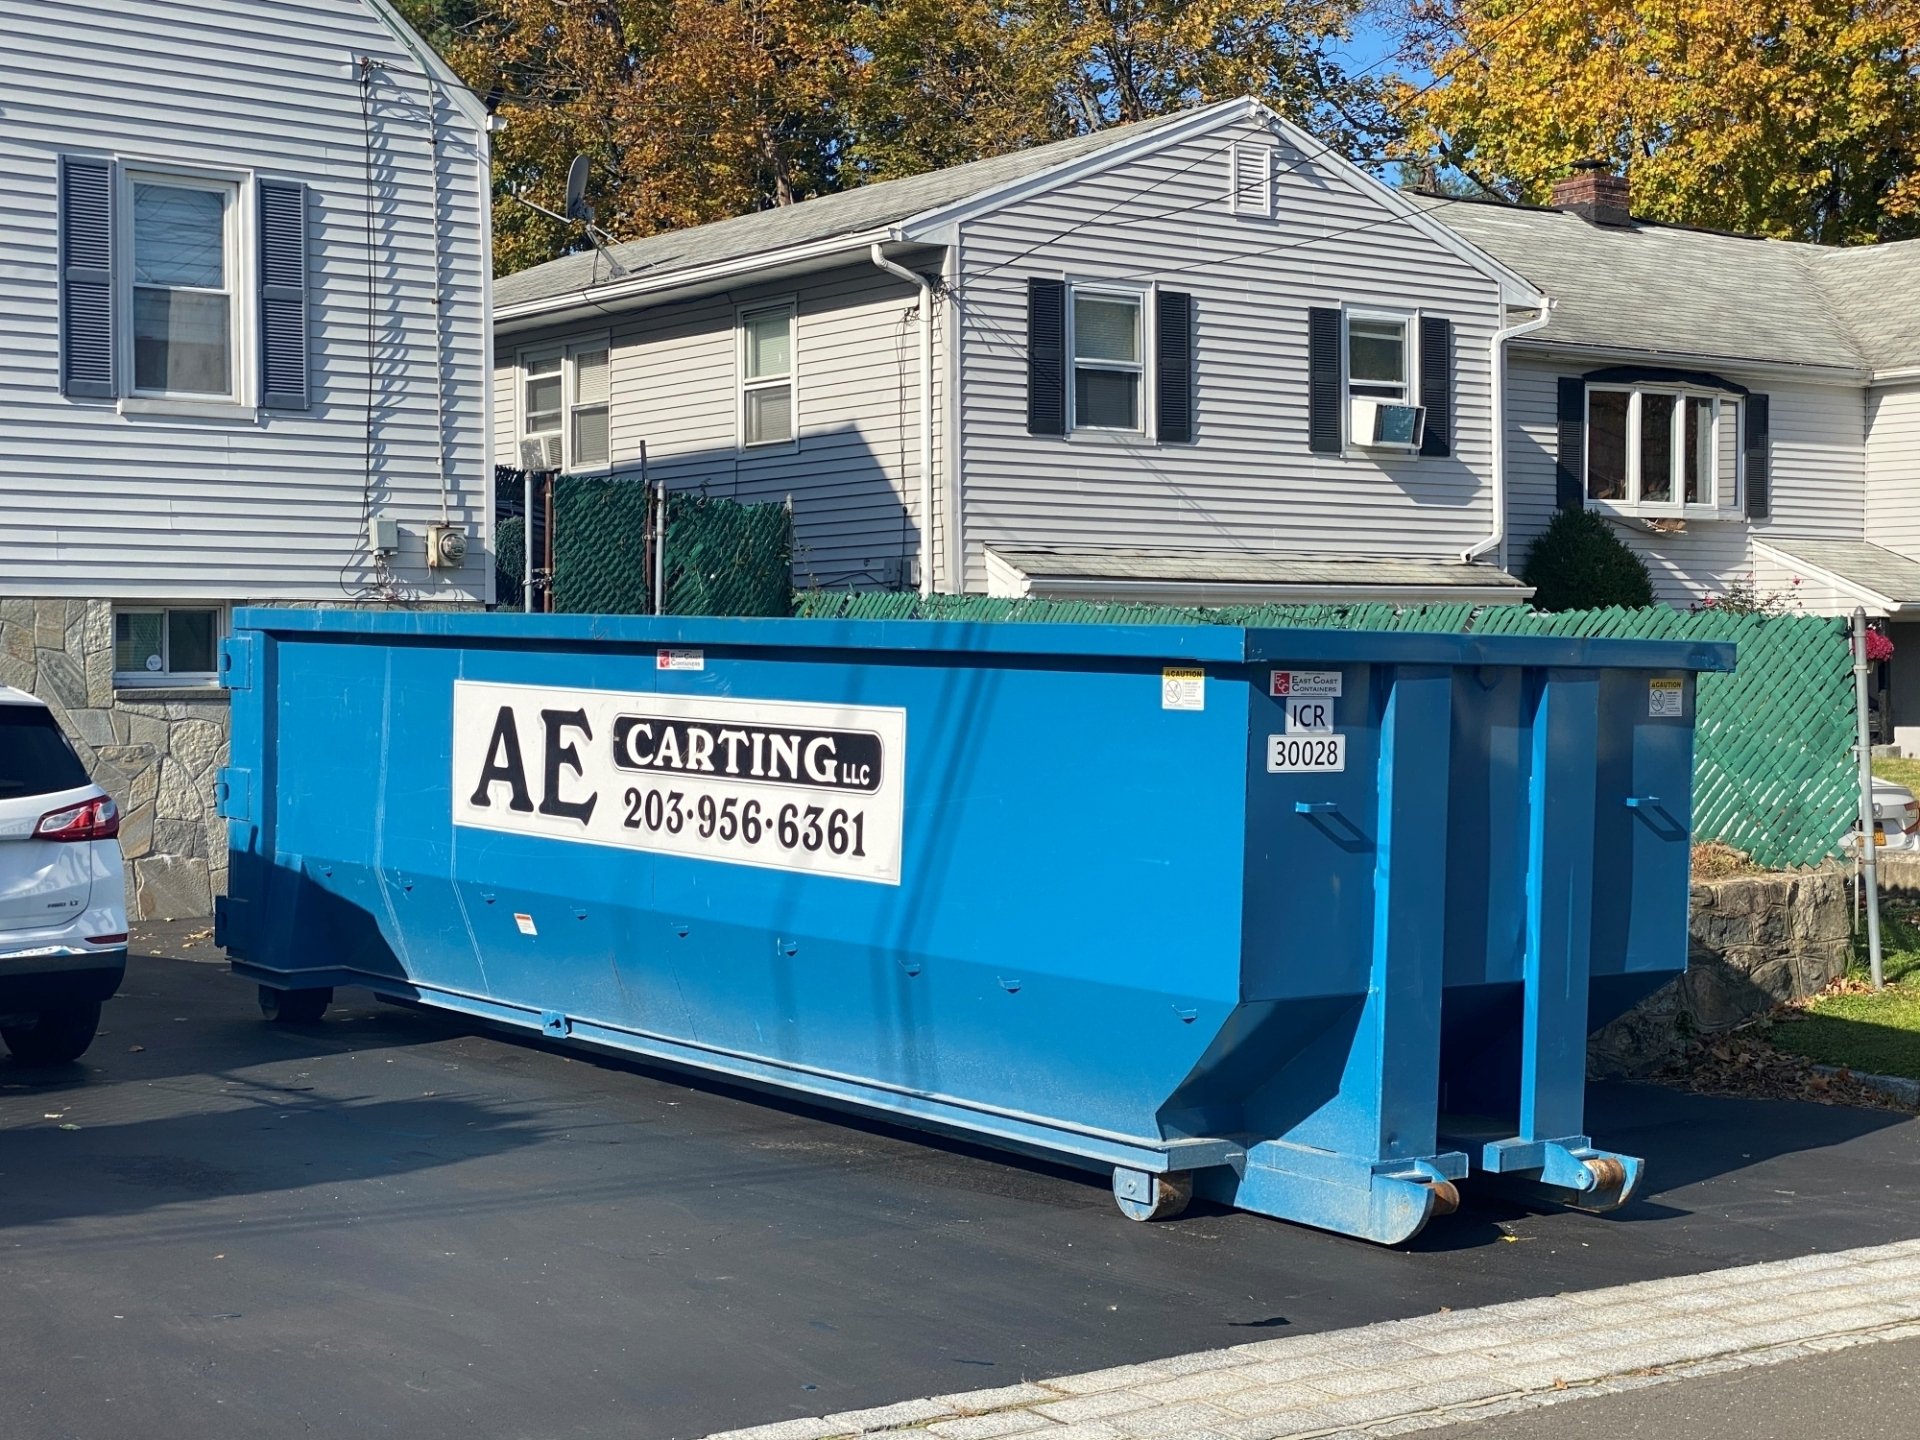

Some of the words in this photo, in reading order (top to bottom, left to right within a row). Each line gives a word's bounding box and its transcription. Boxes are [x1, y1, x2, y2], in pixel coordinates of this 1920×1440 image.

[1170, 670, 1202, 678] CAUTION
[1293, 704, 1325, 727] ICR
[470, 706, 598, 826] AE
[626, 723, 837, 783] CARTING
[843, 764, 870, 786] LLC
[1275, 740, 1338, 766] 30028
